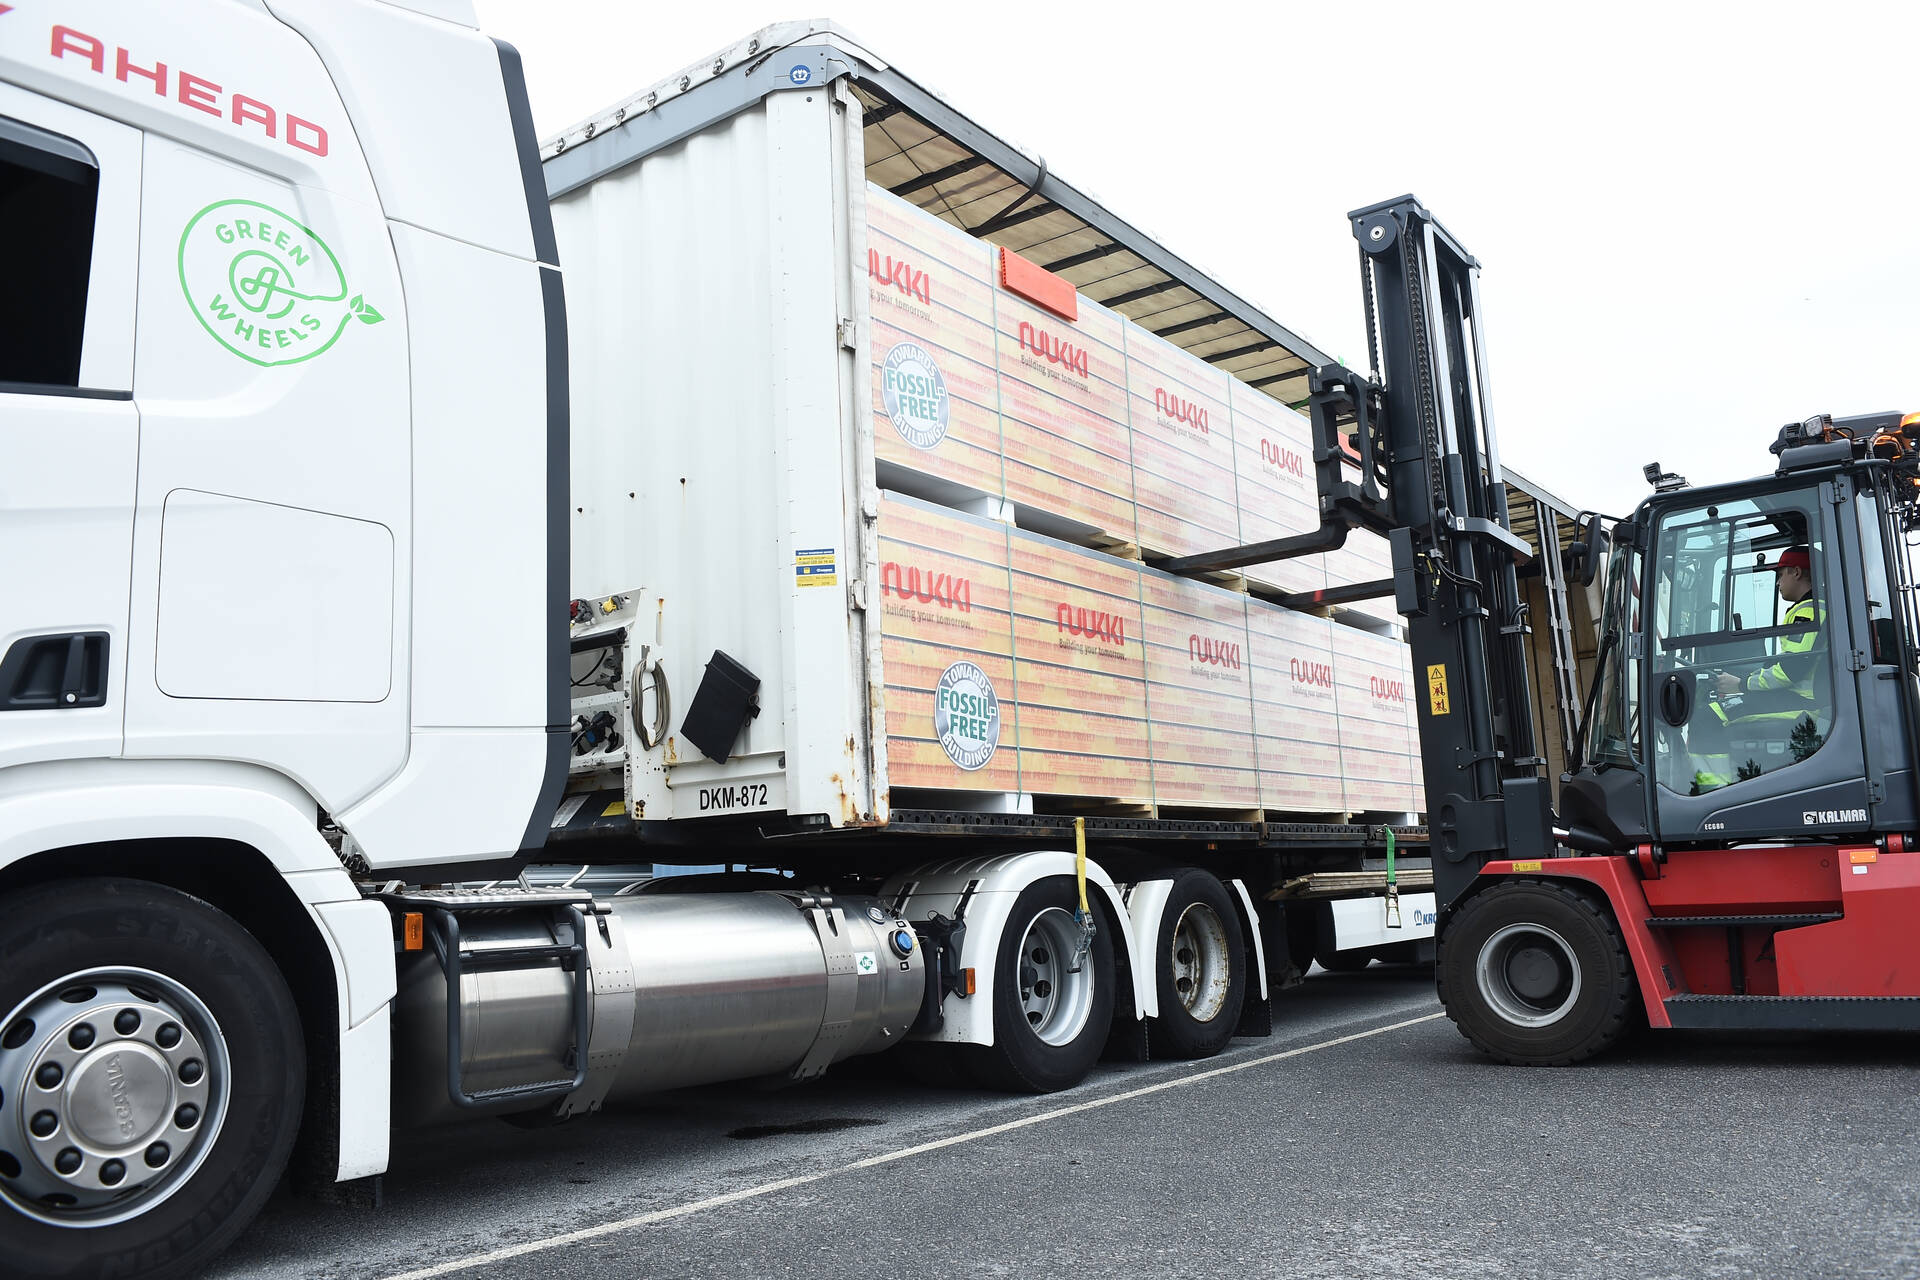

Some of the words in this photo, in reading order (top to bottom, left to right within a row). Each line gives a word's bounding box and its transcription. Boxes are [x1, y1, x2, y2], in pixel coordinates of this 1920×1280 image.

[51, 25, 328, 157] AHEAD
[215, 219, 310, 267] GREEN
[208, 293, 321, 349] WHEELS
[889, 345, 938, 377] TOWARDS
[886, 368, 945, 401] FOSSIL-
[898, 393, 938, 422] FREE
[892, 414, 945, 447] BUILDINGS
[943, 664, 991, 697] TOWARDS
[940, 687, 996, 720] FOSSIL-
[949, 713, 987, 742] FREE
[941, 732, 993, 766] BUILDINGS
[699, 783, 768, 811] DKM-872
[1818, 809, 1867, 824] KALMAR
